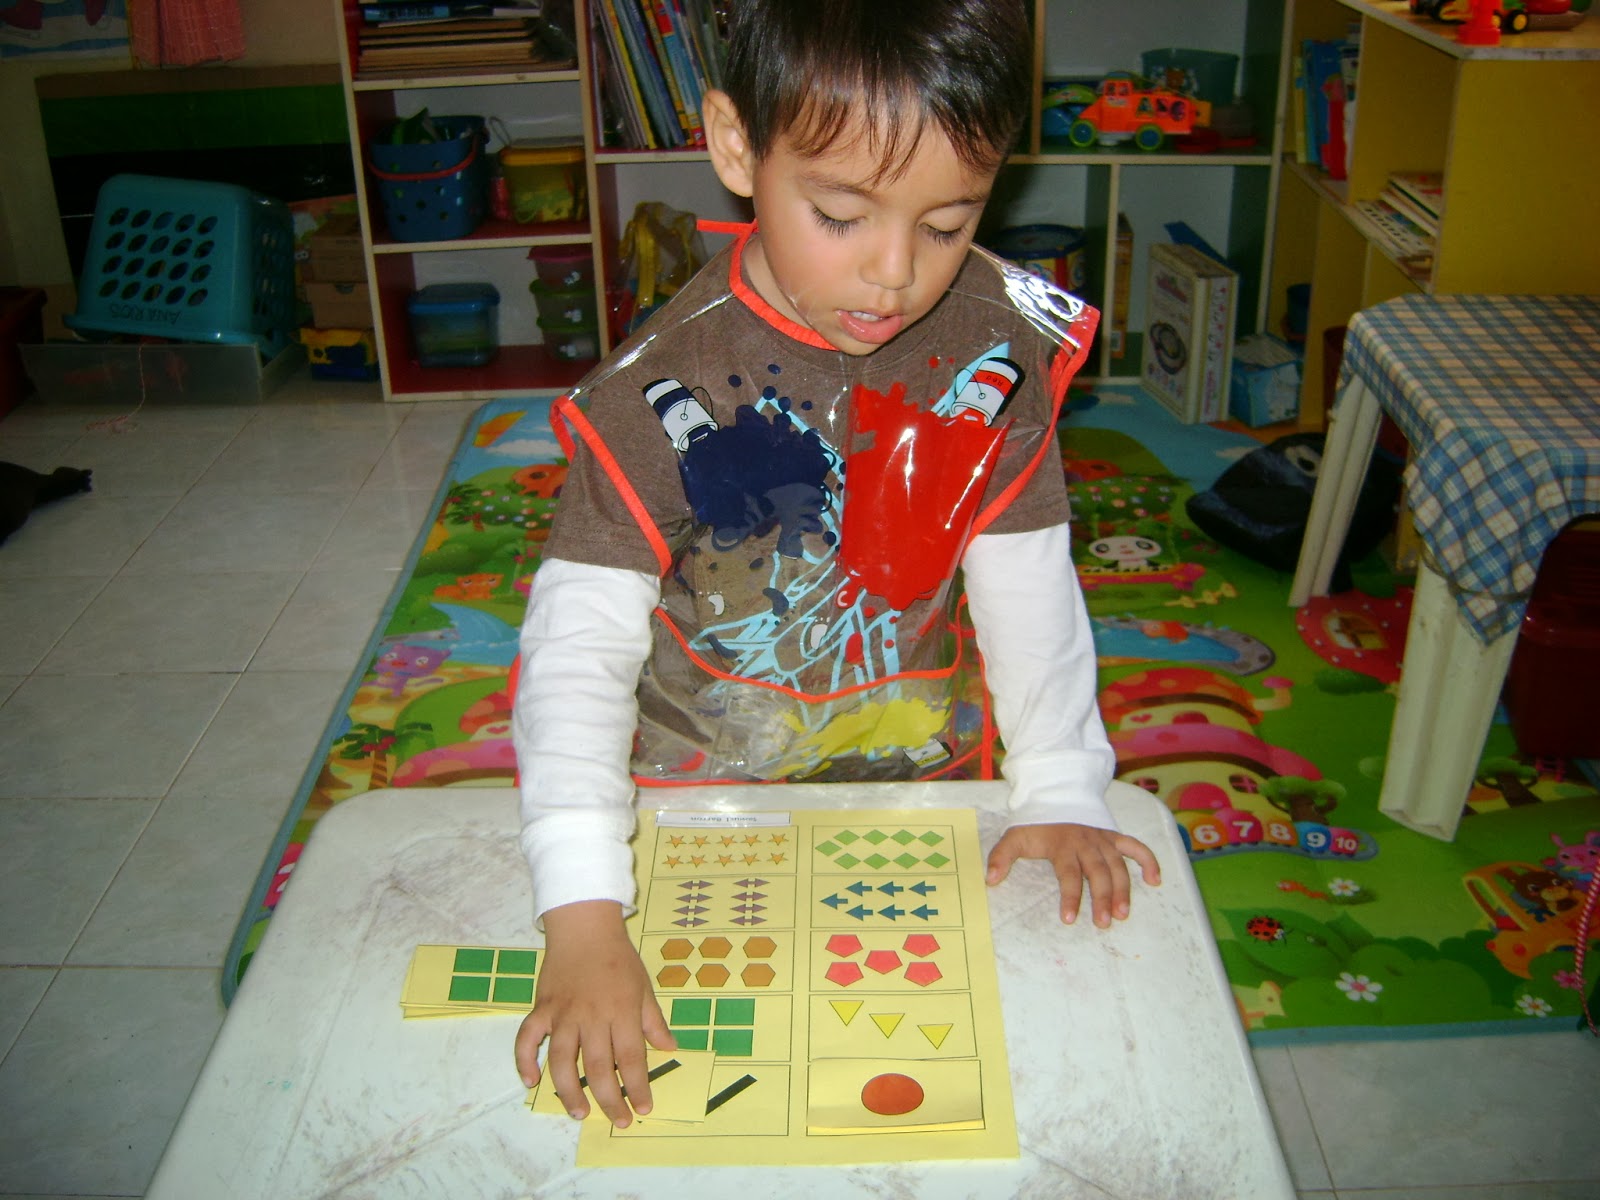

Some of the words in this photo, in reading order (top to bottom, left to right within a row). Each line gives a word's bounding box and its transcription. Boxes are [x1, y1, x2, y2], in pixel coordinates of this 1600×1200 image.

[1193, 824, 1220, 844] 6
[1232, 821, 1254, 838] 7
[1269, 823, 1292, 841] 8
[1306, 832, 1327, 848] 9
[1333, 836, 1358, 851] 10
